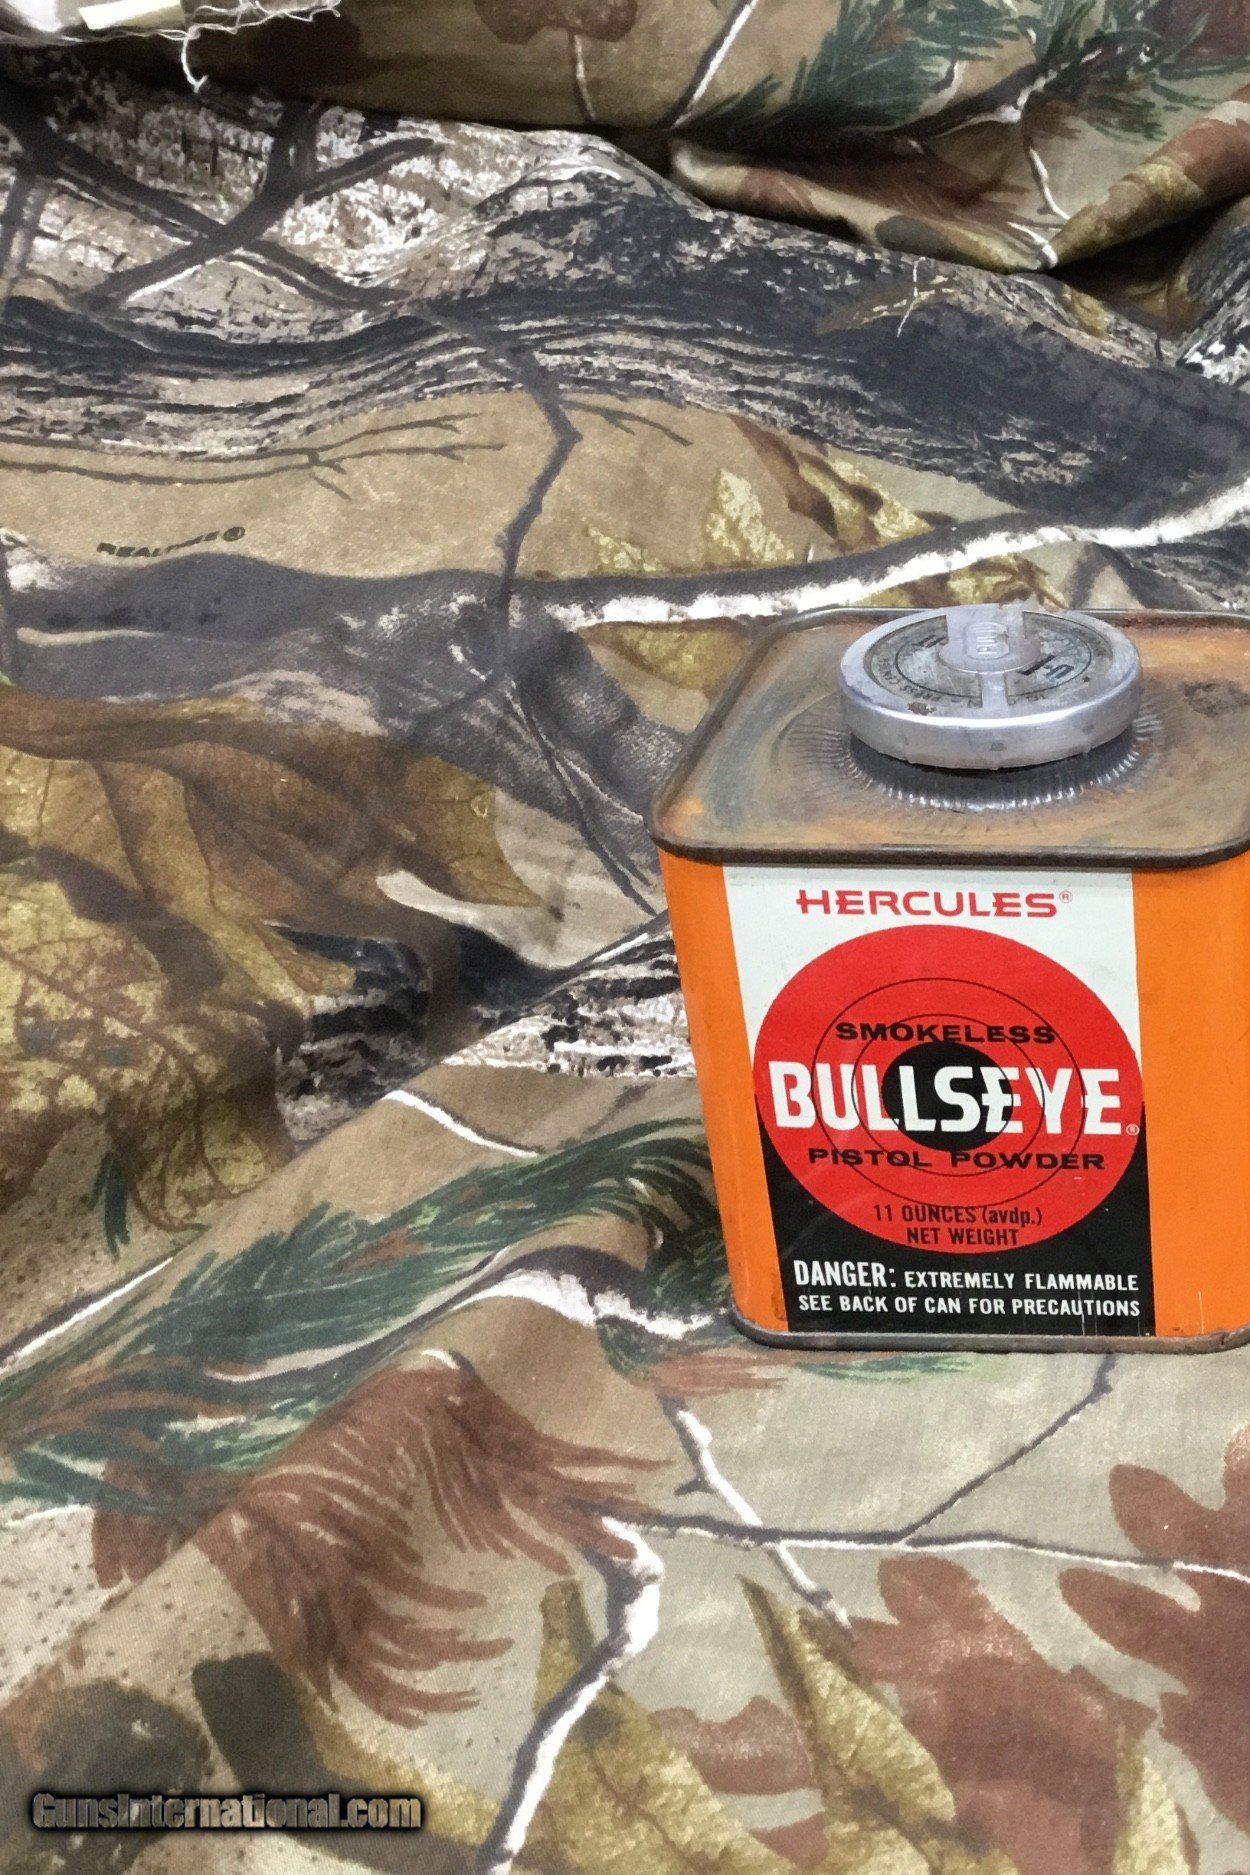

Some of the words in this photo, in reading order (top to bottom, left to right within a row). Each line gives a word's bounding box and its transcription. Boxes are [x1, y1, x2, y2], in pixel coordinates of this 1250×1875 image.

[835, 1021, 1057, 1045] SMOKELESS
[808, 1147, 933, 1169] PISTOL
[950, 1150, 1107, 1172] POWDER
[873, 1203, 894, 1222] 11
[902, 1204, 977, 1224] OUNCES
[981, 1204, 1043, 1228] (avdp.)
[906, 1227, 941, 1245] NET
[947, 1228, 1020, 1247] WEIGHT
[793, 1260, 897, 1289] DANGER:
[904, 1271, 1016, 1290] EXTREMELY
[1023, 1273, 1140, 1292] FLAMMABLE
[798, 1294, 831, 1312] SEE
[839, 1295, 889, 1313] BACK
[894, 1296, 919, 1314] OF
[923, 1297, 962, 1315] CAN
[968, 1298, 1006, 1315] FOR
[1012, 1298, 1141, 1318] PRECAUTIONS
